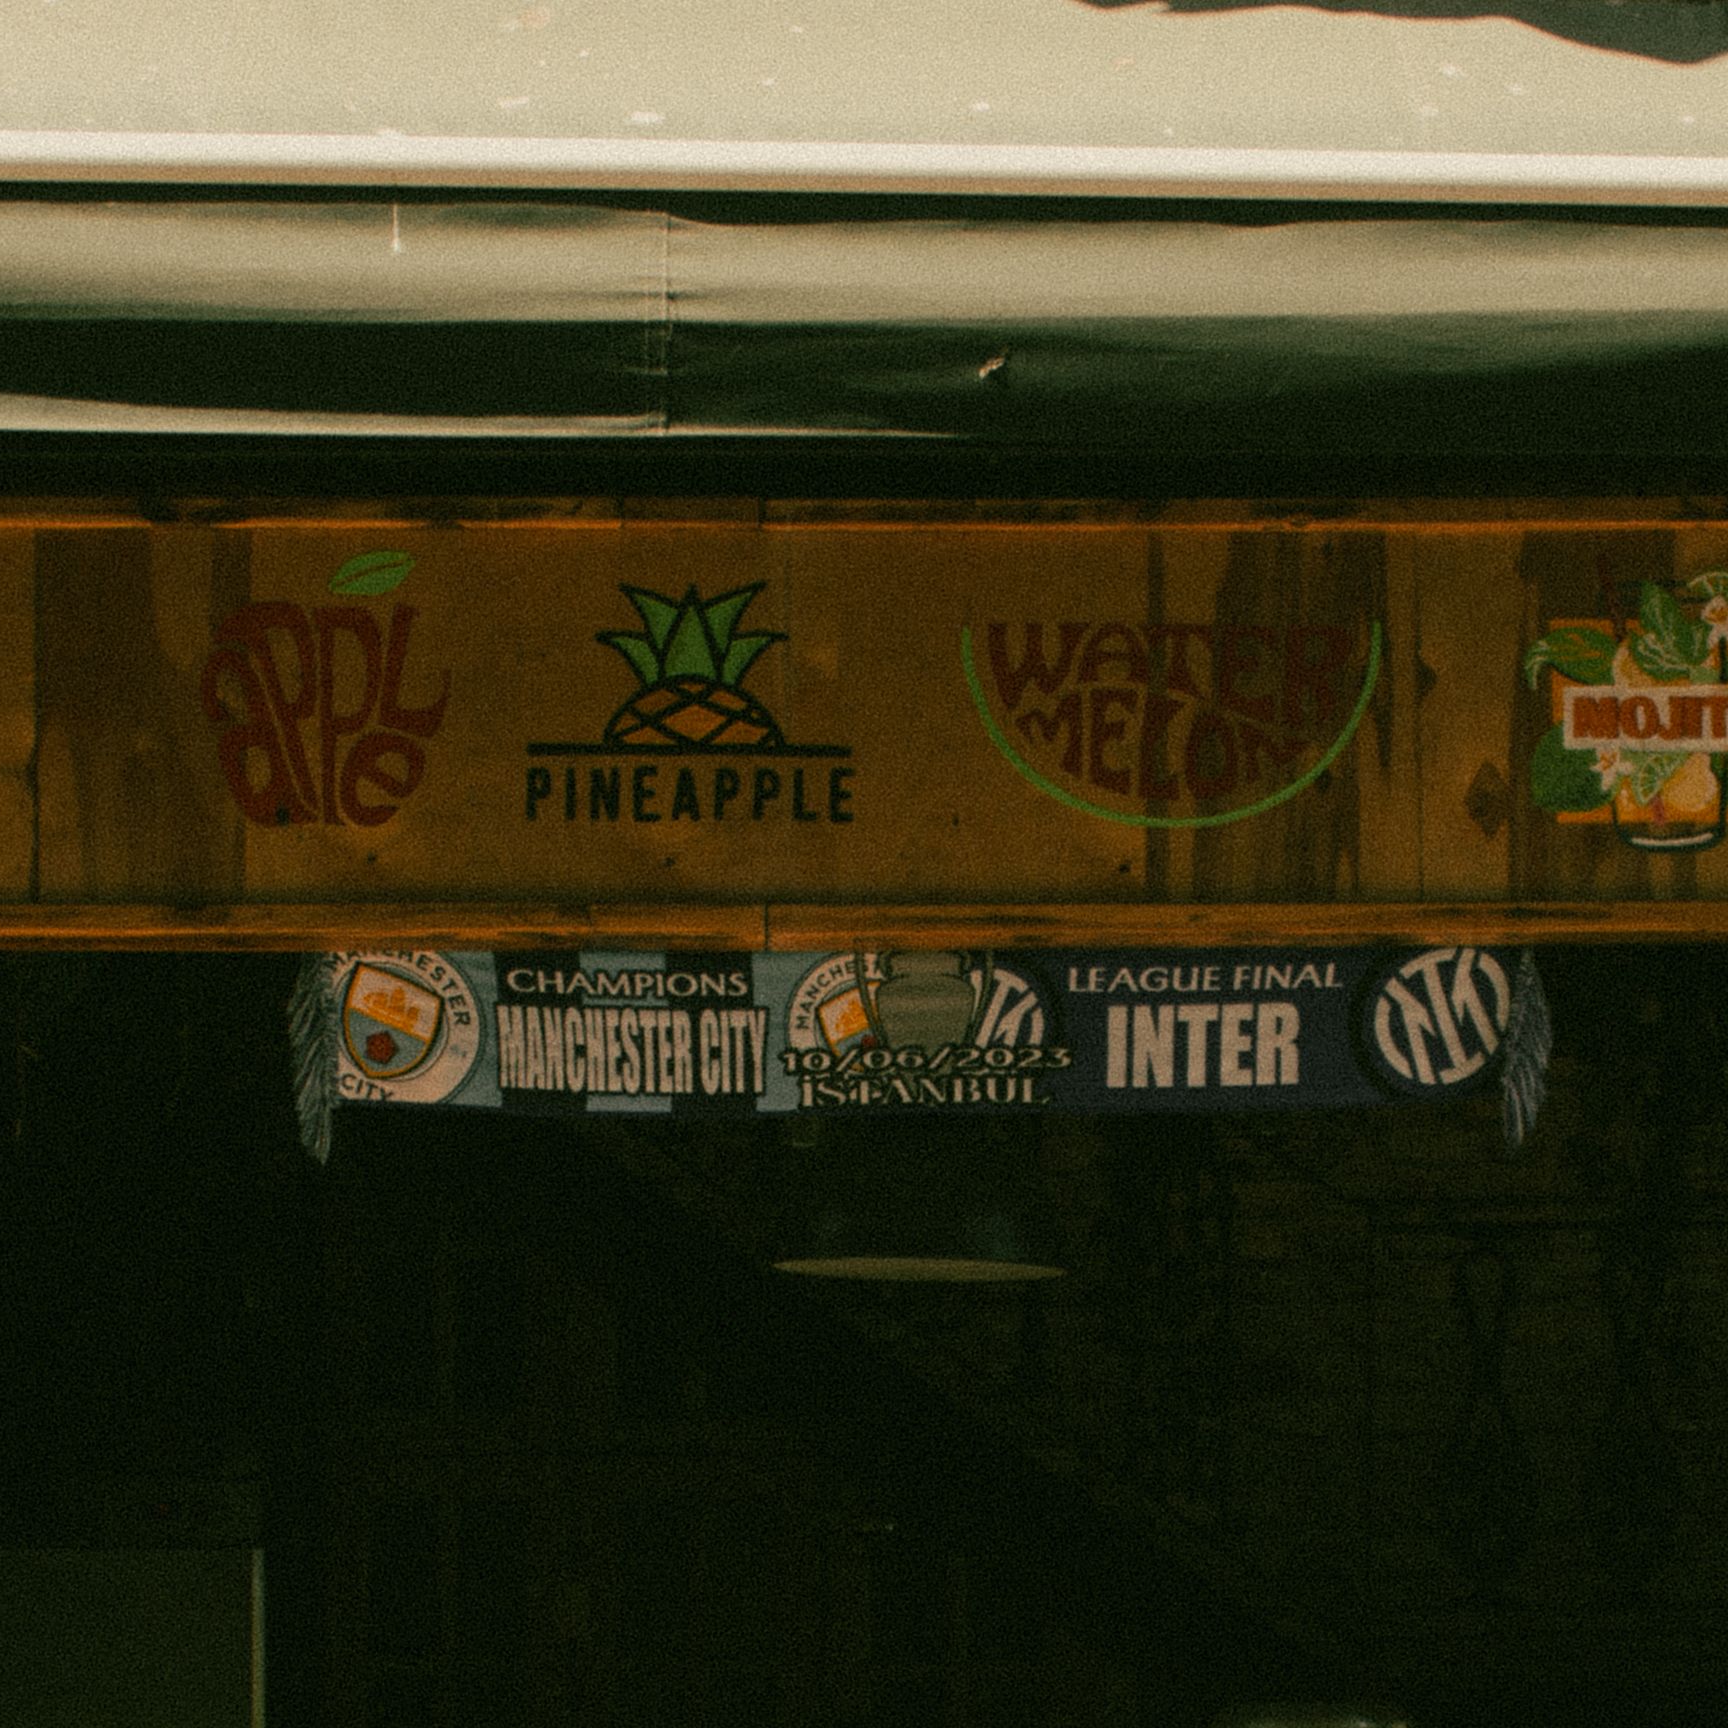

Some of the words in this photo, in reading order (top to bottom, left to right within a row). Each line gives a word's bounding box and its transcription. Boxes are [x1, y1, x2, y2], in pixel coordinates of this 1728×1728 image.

[986, 620, 1358, 732] WATER
[1014, 686, 1316, 802] MELON
[524, 765, 857, 824] PINEAPPLE
[504, 965, 750, 1000] CHAMPIONS
[1068, 966, 1222, 993] LEAGUE
[1231, 961, 1345, 992] FINAL
[496, 1002, 690, 1095] MANCHESTER
[698, 1006, 771, 1097] CITY
[780, 1044, 1073, 1075] 10/06/2023
[1104, 1001, 1302, 1089] INTER
